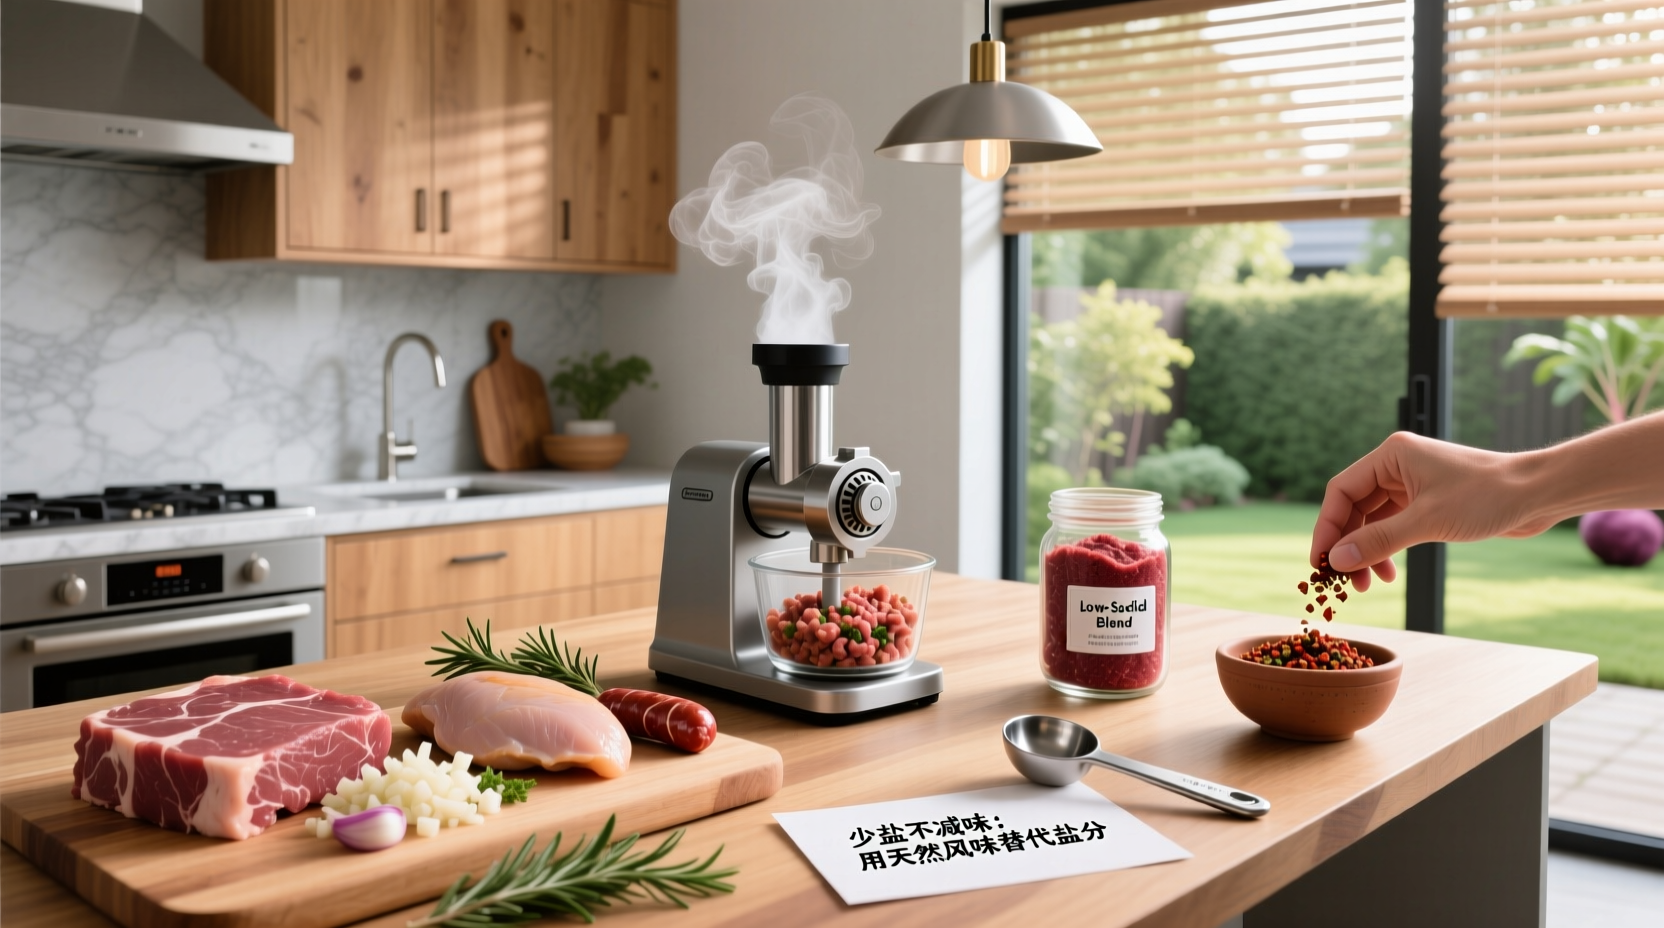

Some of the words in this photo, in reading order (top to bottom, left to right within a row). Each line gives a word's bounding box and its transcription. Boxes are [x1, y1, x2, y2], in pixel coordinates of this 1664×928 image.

[1096, 616, 1133, 629] Blend
[858, 820, 1107, 871] 用天然风味替代盐分
